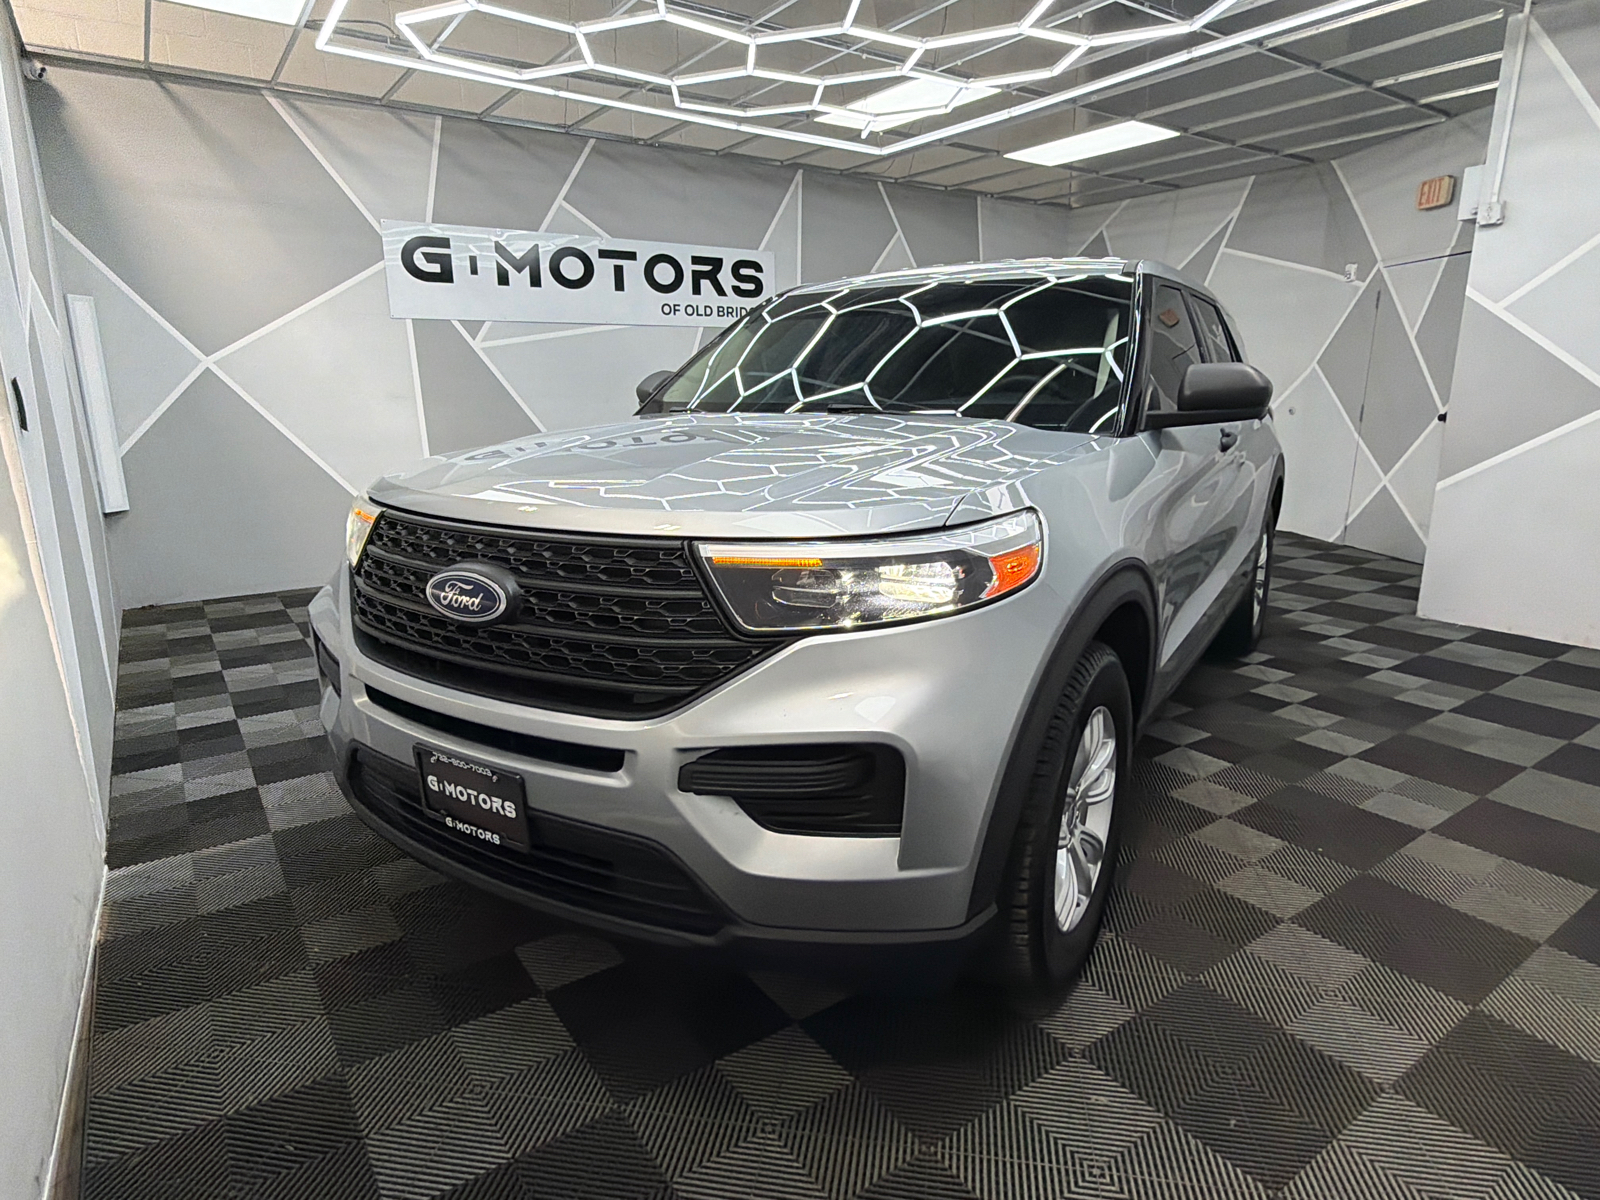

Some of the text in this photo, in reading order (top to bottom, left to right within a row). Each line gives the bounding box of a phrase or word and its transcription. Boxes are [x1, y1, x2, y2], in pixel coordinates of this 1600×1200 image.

[661, 303, 681, 315] OF
[684, 304, 713, 317] OLD
[440, 581, 484, 611] Ford
